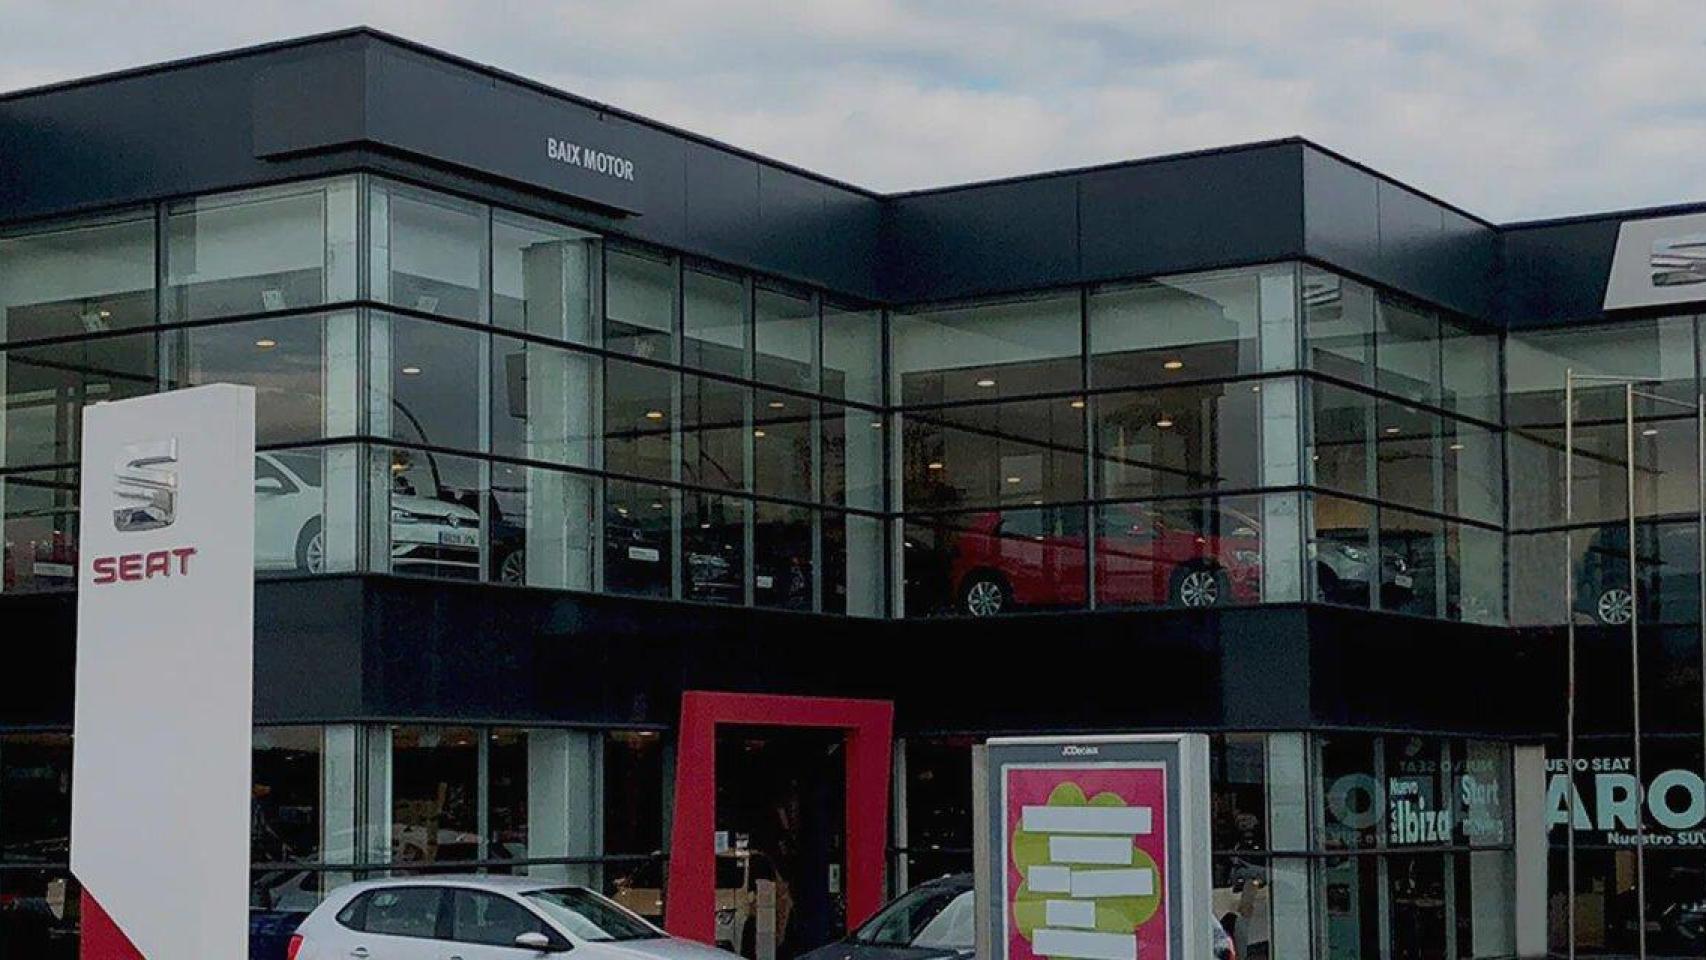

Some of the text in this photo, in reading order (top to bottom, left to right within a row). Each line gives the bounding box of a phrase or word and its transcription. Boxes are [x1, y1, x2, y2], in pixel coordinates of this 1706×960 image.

[548, 137, 634, 181] BAIX MOTOR
[92, 547, 198, 585] SEAT
[1592, 757, 1631, 771] SEAT
[1462, 774, 1499, 806] Start
[1397, 796, 1450, 844] Ibiza
